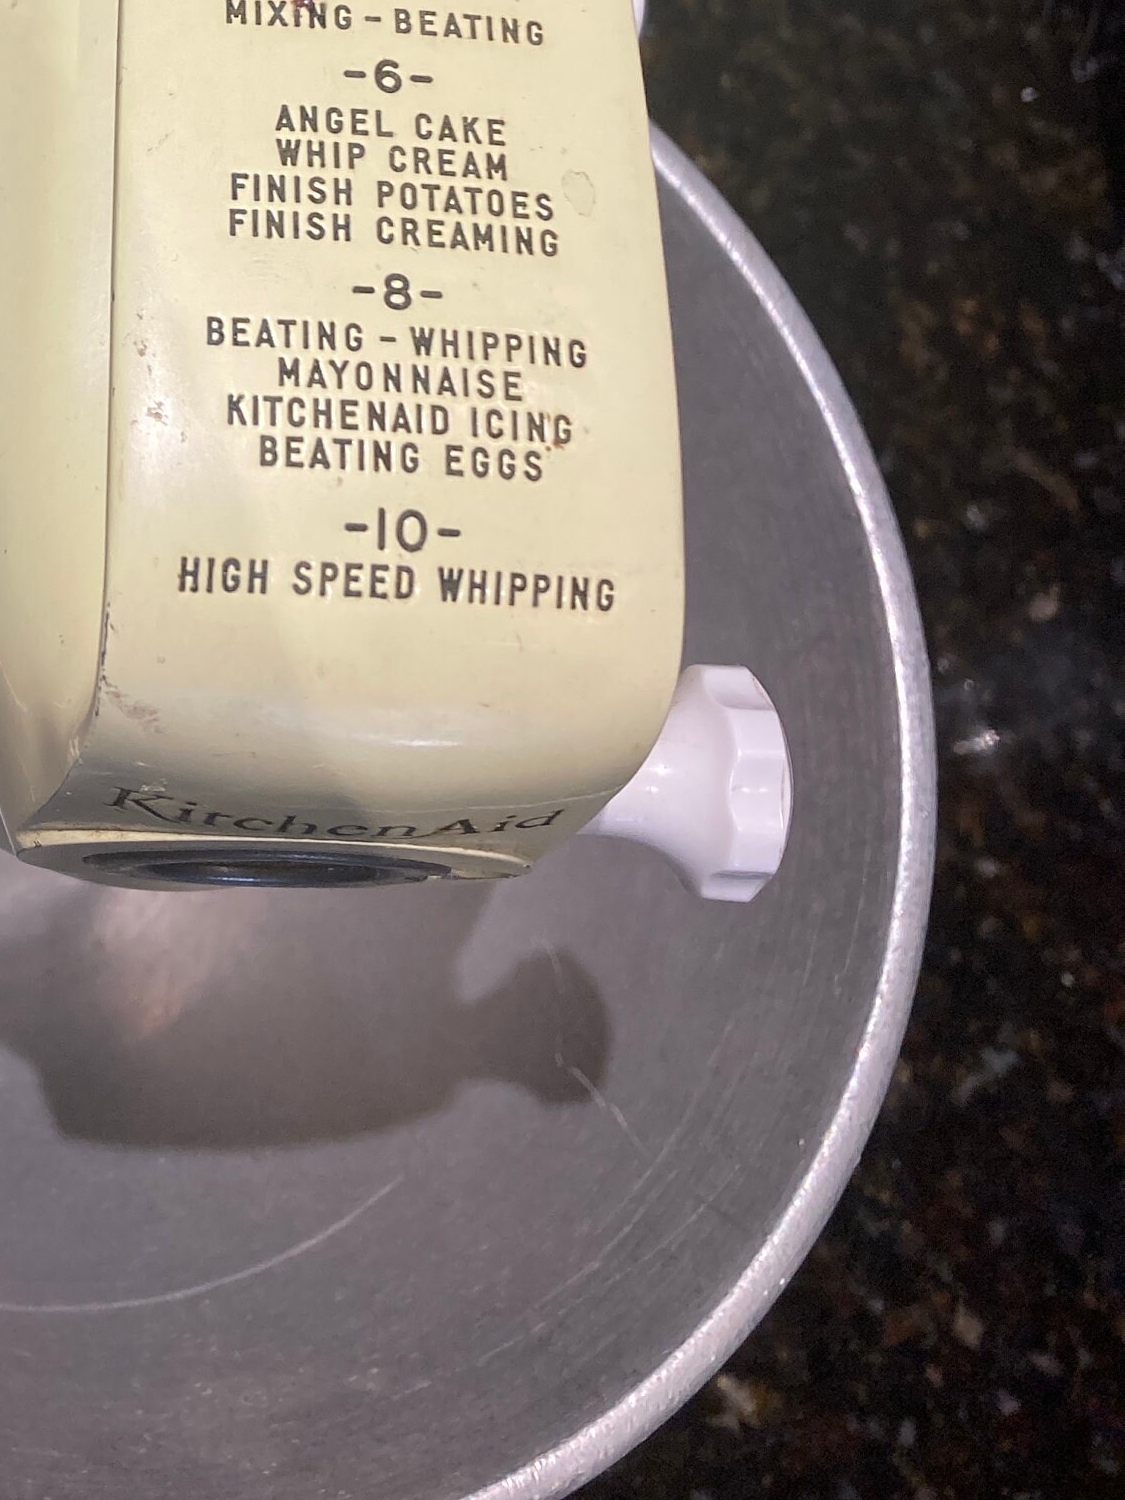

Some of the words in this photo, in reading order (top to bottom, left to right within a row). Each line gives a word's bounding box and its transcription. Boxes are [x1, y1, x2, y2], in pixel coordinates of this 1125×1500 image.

[275, 104, 394, 138] ANGEL
[414, 113, 507, 147] CAKE
[275, 139, 366, 170] WHIP
[388, 145, 508, 180] CREAM
[230, 173, 353, 206] FINISH
[377, 181, 555, 221] POTATOES
[229, 209, 353, 242] FINISH
[376, 217, 559, 257] CREAMING
[277, 358, 523, 402] MAYONNAISE
[227, 395, 449, 435] KITCHENAID
[471, 407, 573, 445] ICING
[258, 437, 420, 473] BEATING
[446, 445, 544, 481] EGGS
[179, 557, 269, 595] HIGH
[293, 562, 415, 600] SPEED
[439, 567, 615, 612] WHIPPING
[105, 786, 562, 839] KitchenAid
